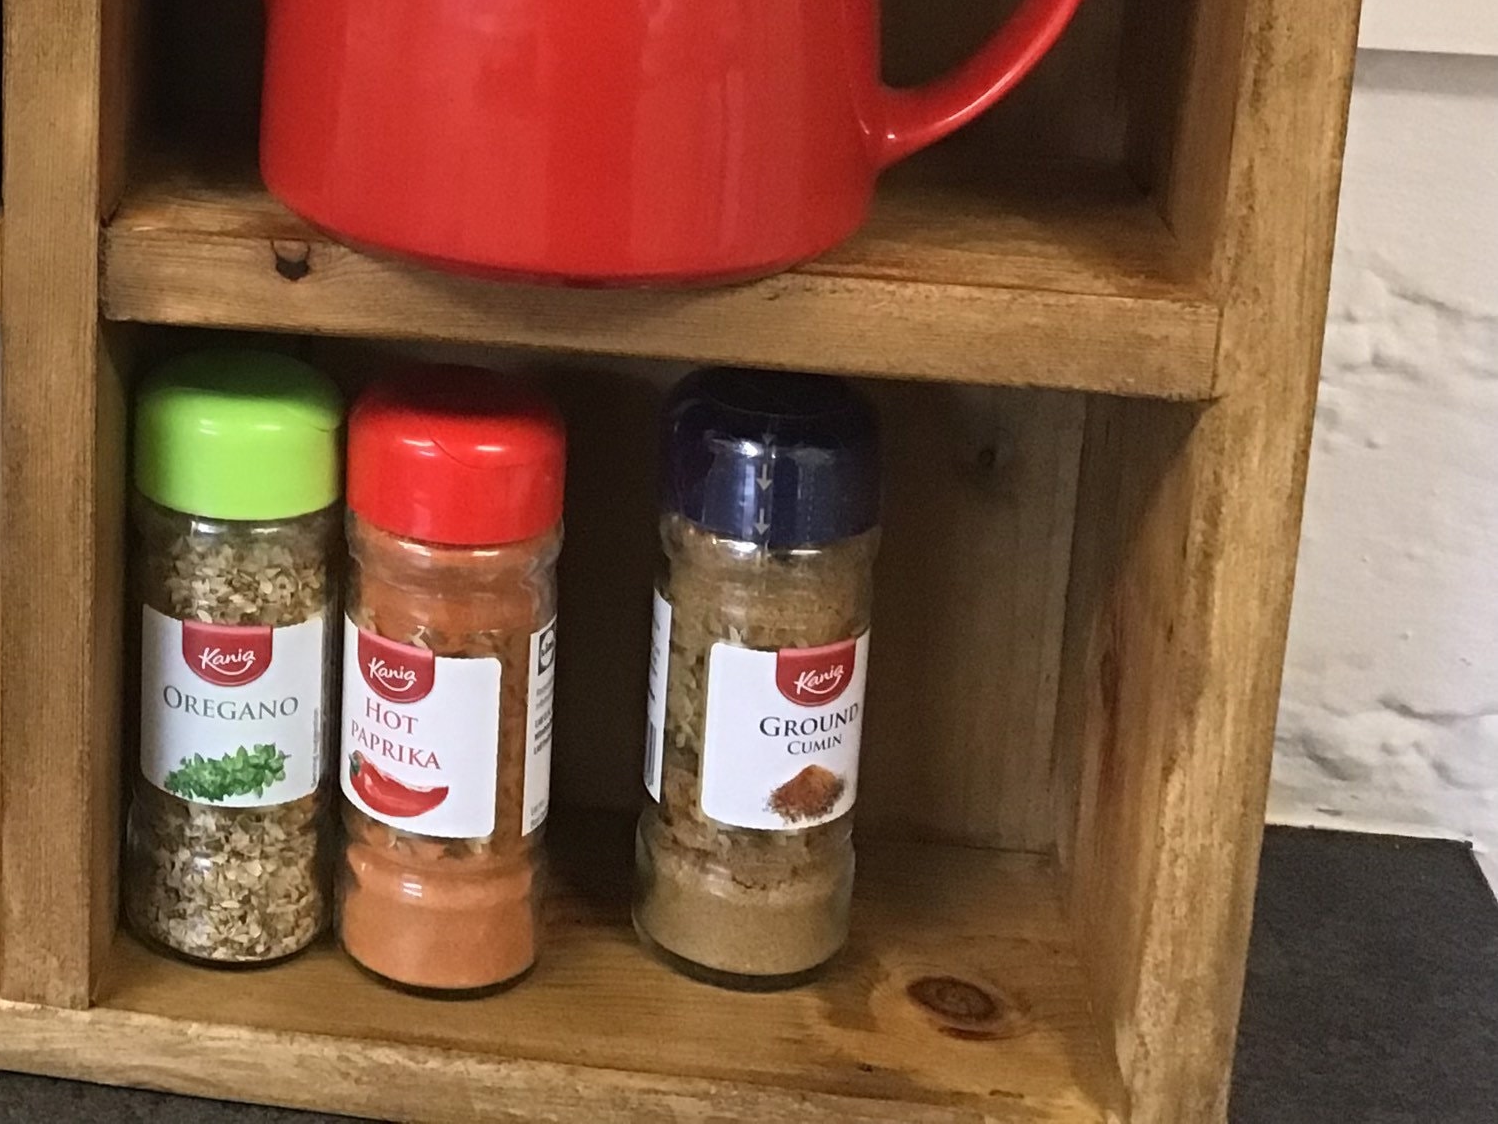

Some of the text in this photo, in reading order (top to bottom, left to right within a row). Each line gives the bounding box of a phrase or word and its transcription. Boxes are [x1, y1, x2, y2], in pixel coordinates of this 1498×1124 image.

[198, 647, 256, 675] Kania
[368, 657, 417, 692] Kania
[794, 664, 844, 695] Kania
[163, 685, 299, 721] OREGANO
[366, 696, 419, 736] HOT
[759, 702, 859, 737] GROUND
[351, 719, 442, 771] PAPRIKA
[787, 733, 843, 755] CUMIN
